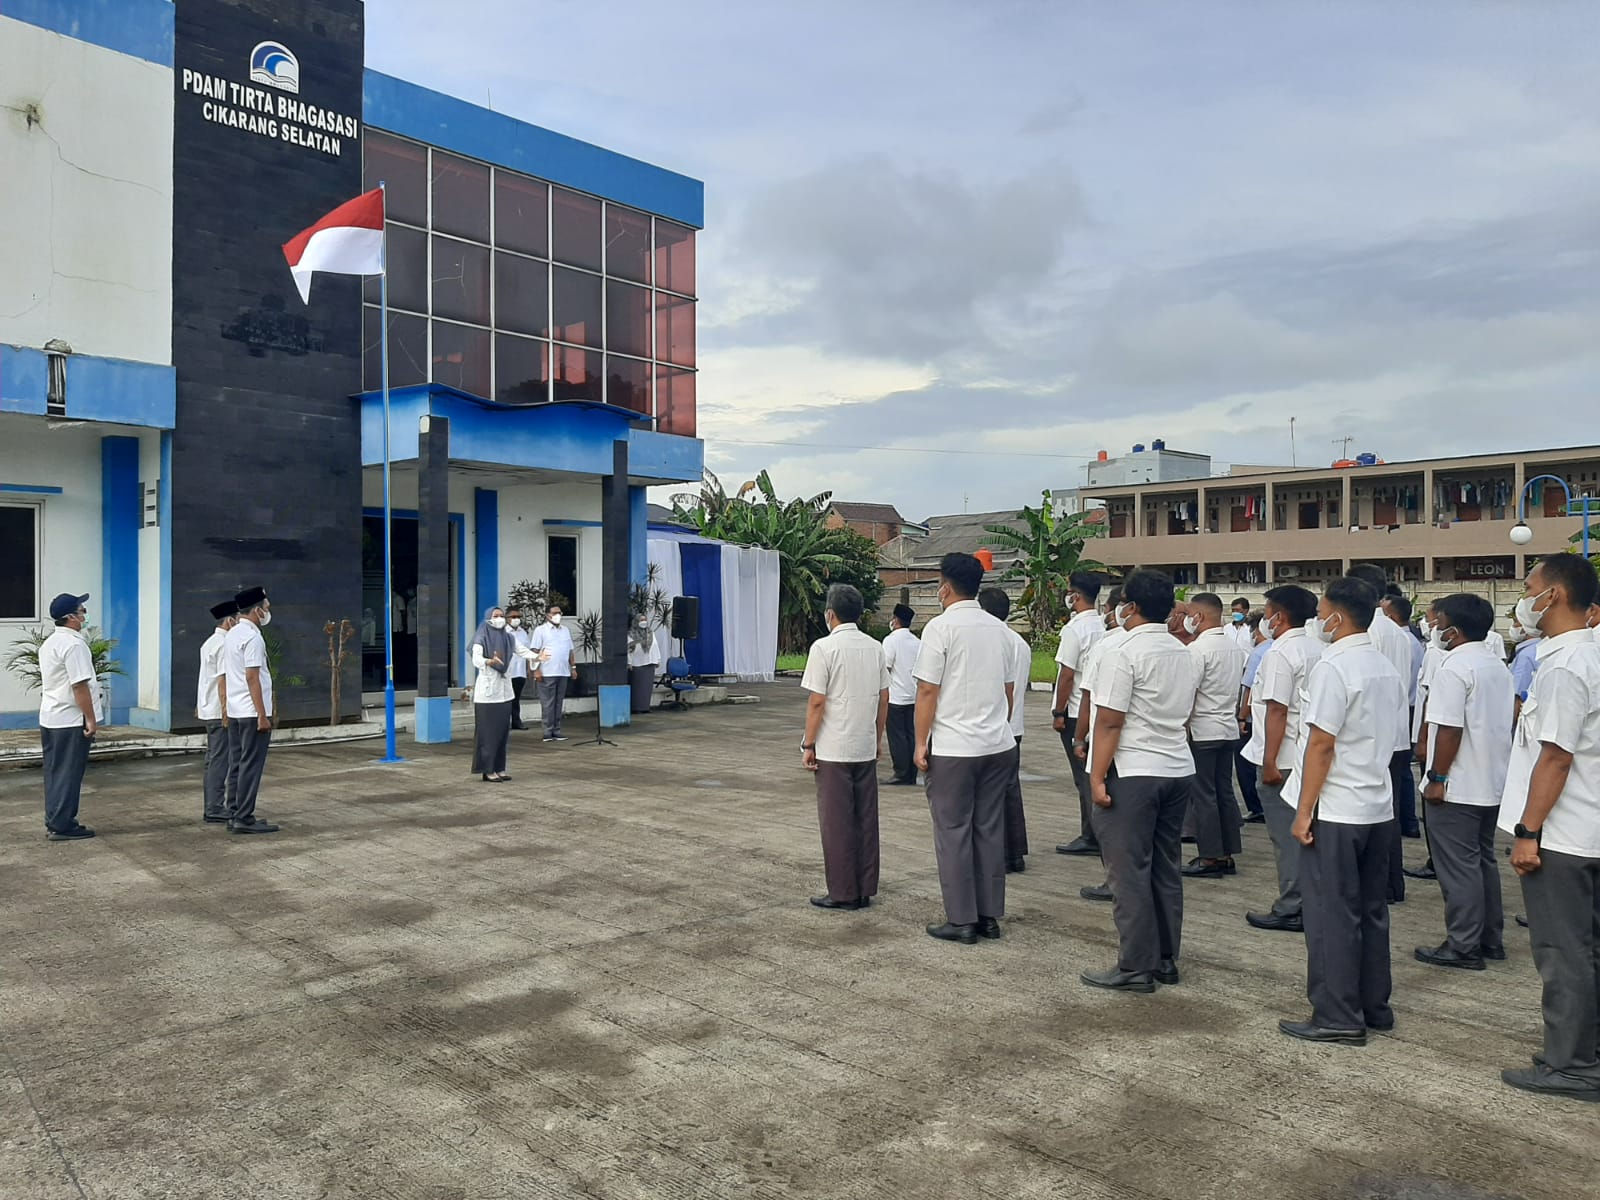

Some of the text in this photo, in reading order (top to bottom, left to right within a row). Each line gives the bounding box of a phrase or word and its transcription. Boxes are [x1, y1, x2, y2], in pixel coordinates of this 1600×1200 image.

[182, 68, 226, 101] PDAM
[230, 82, 274, 115] TIRTA
[278, 95, 358, 139] BHAGASASI
[203, 101, 340, 156] CIKARANG SELATAN
[1470, 564, 1505, 575] LEON
